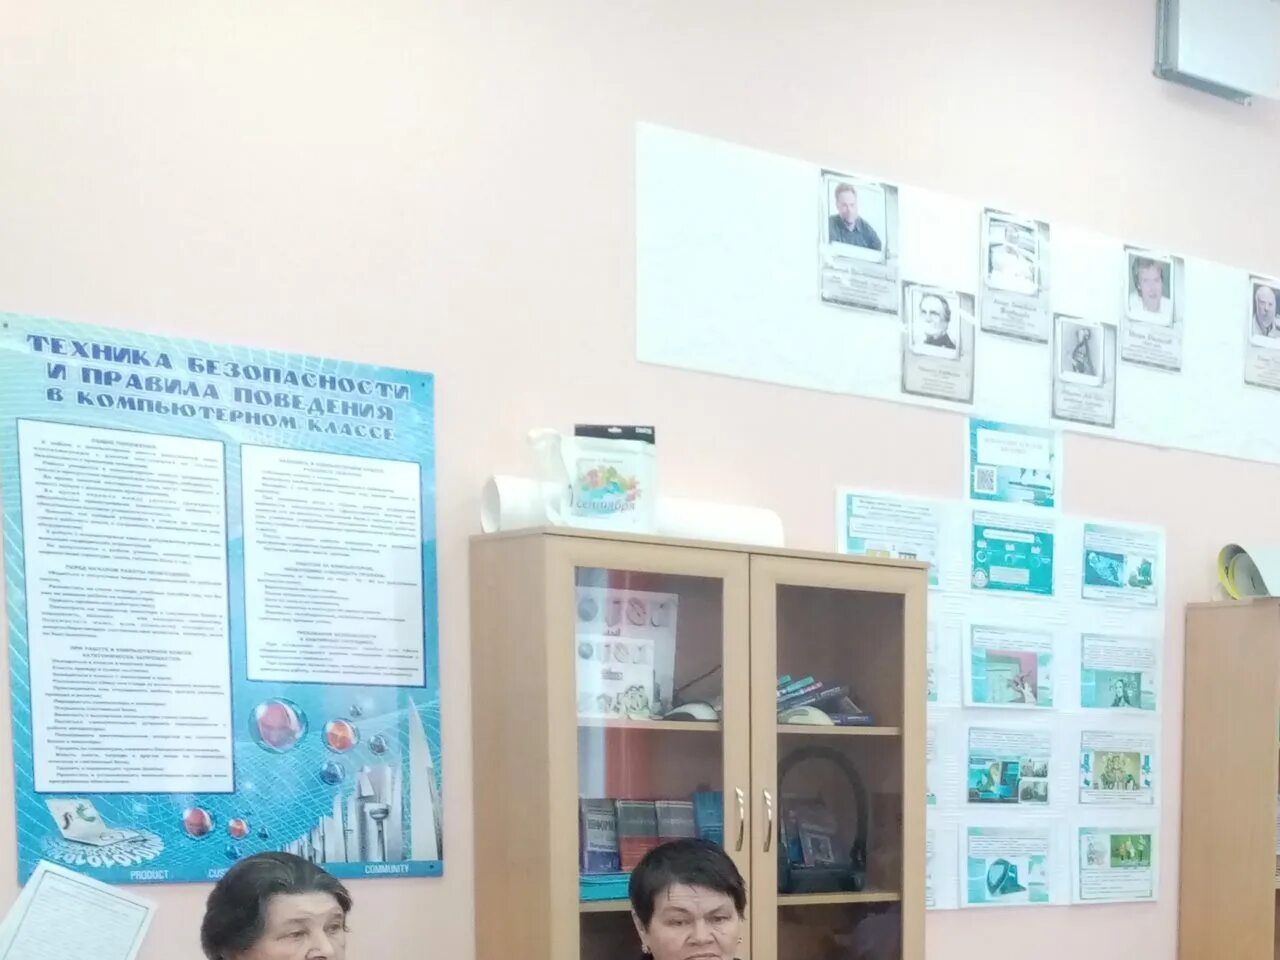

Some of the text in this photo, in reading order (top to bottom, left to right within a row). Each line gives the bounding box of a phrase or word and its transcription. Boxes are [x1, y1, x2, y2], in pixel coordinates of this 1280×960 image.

[26, 334, 411, 401] ТЕХНИКА БЕЗОПАСНОСТИ
[47, 363, 394, 421] И ПРАВИЛА ПОВЕДЕНИЯ
[47, 387, 395, 441] В КОМПЬЮТЕРНОМ КЛАССЕ
[130, 870, 169, 880] PRODUCT
[364, 864, 410, 874] COMMUNITY
